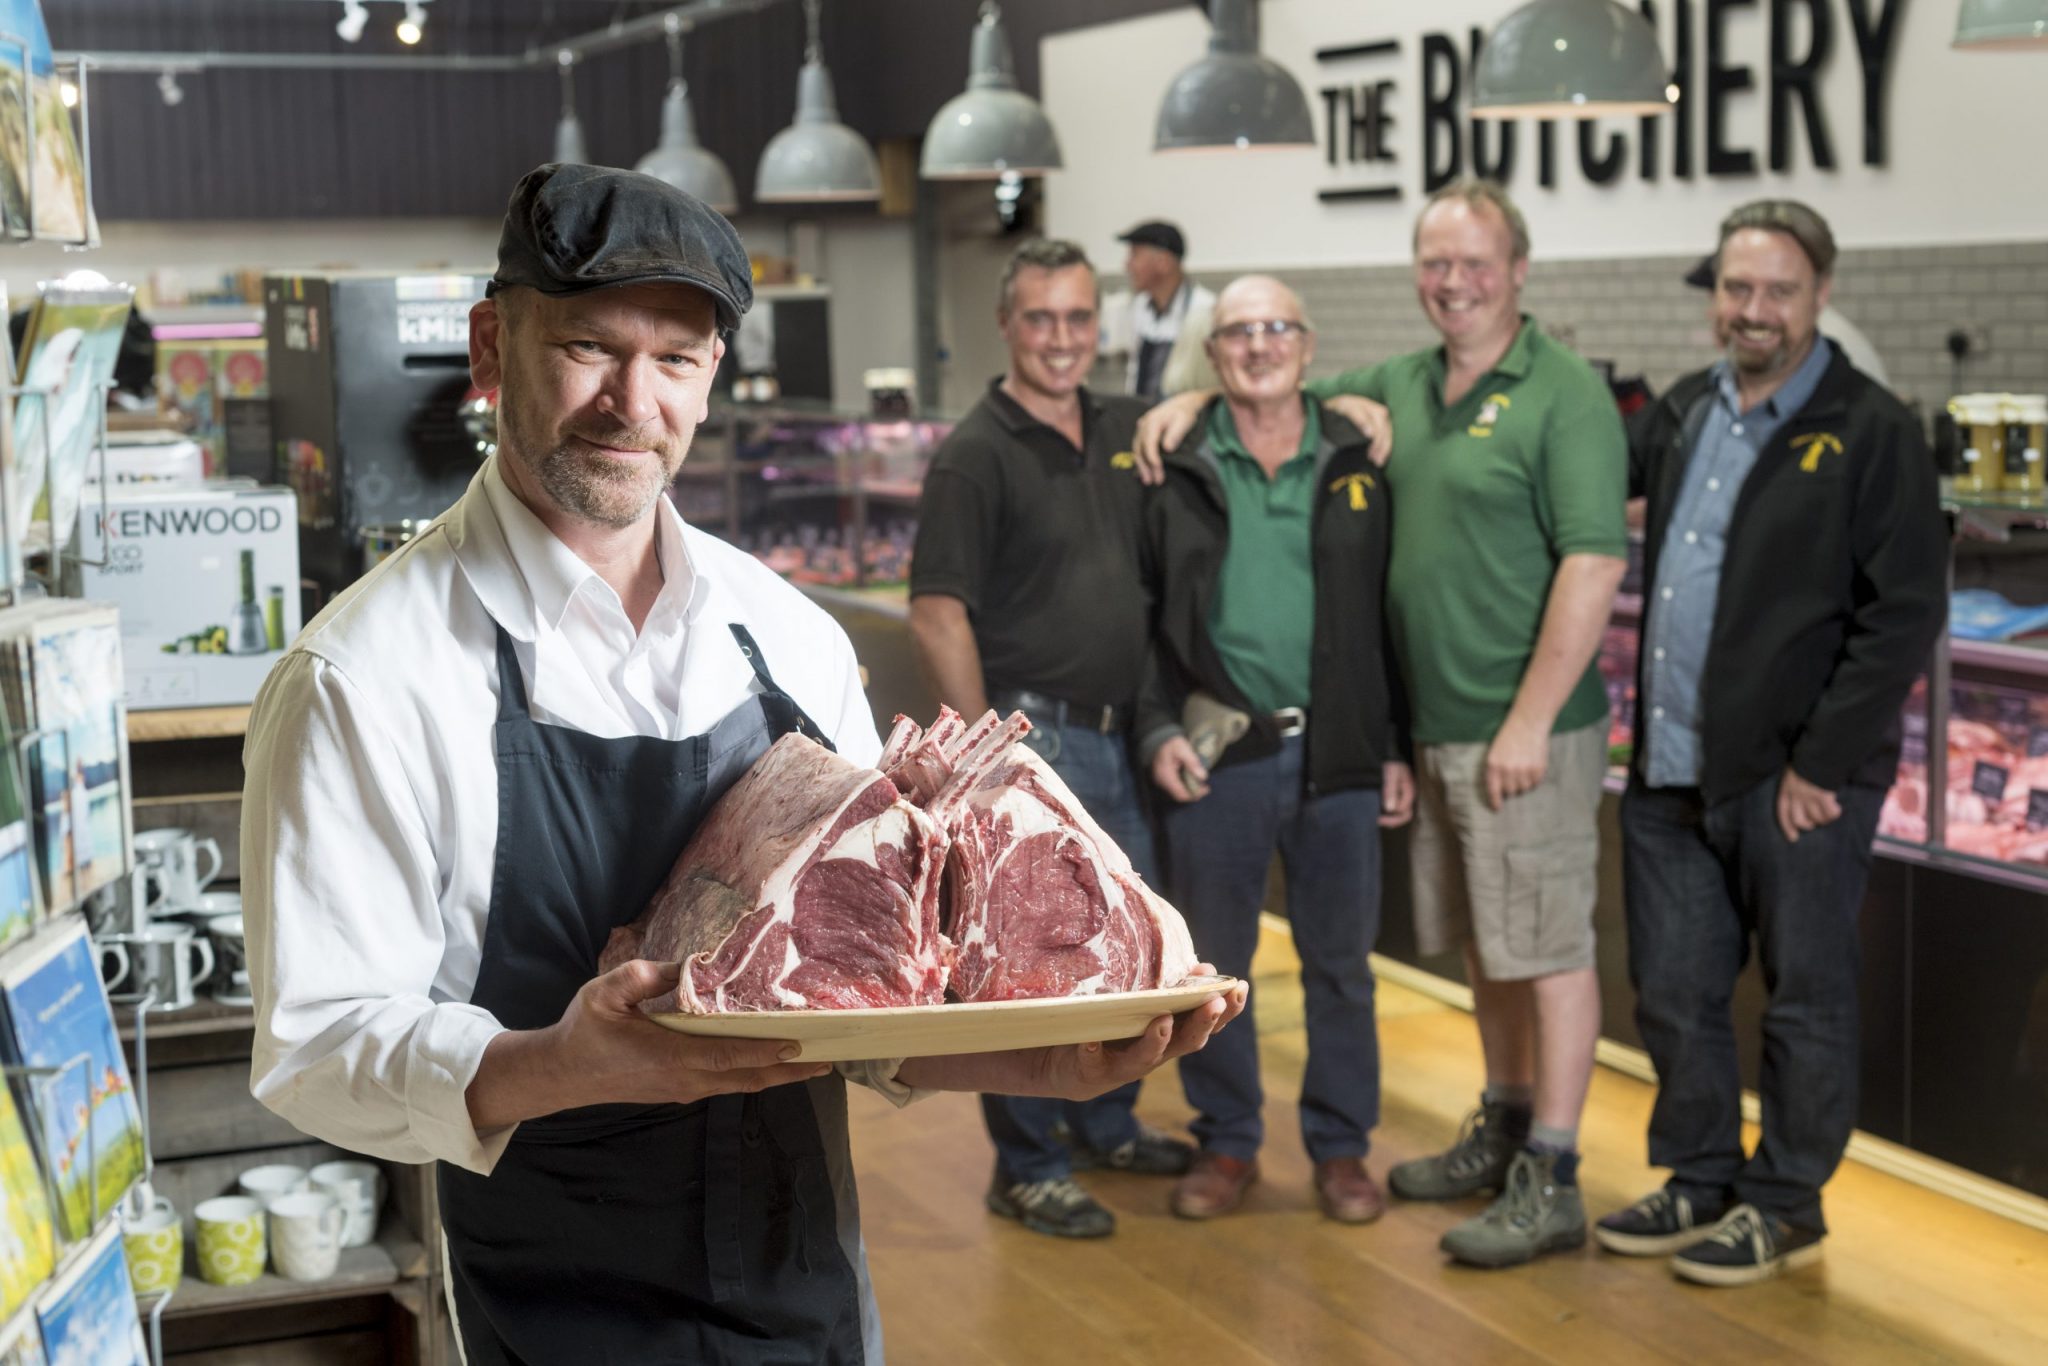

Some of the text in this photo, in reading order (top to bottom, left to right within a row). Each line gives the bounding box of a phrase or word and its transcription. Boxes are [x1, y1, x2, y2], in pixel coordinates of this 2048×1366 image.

[1319, 80, 1396, 166] THE
[94, 507, 282, 538] KENWOOD
[103, 544, 142, 562] GO
